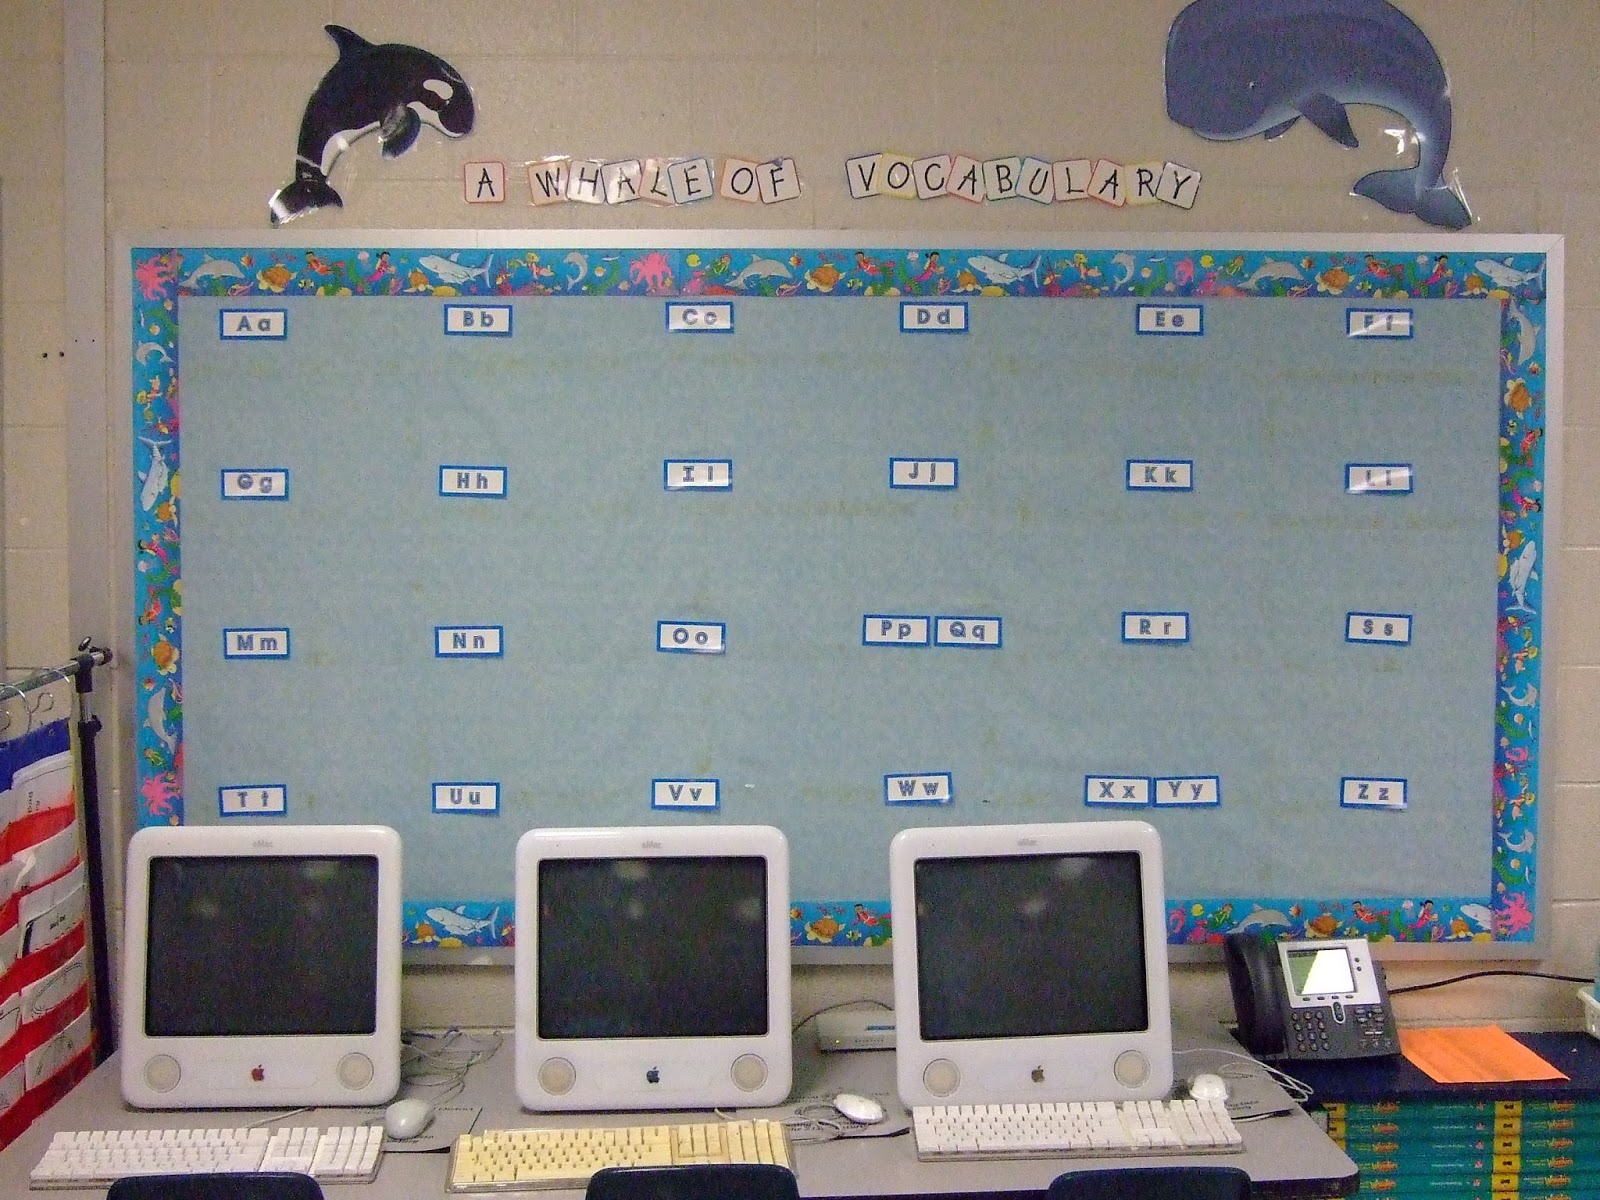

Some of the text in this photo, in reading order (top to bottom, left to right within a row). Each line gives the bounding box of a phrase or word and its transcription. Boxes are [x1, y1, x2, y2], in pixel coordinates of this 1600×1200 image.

[477, 161, 1191, 200] A WHALE OF VOCABULARY
[236, 315, 271, 332] Aa
[463, 311, 494, 327] Bb
[682, 308, 717, 324] Cc
[916, 308, 950, 324] Dd
[1155, 311, 1184, 327] Ee
[457, 473, 488, 489] Hh
[1145, 467, 1177, 483] Kk
[237, 475, 272, 493] Gg
[881, 620, 911, 640] Pp
[949, 621, 985, 641] Qq
[1139, 619, 1171, 634] Rr
[1362, 619, 1393, 635] Ss
[237, 634, 278, 651] Mm
[453, 632, 485, 649] Nn
[673, 628, 708, 643] Oo
[669, 785, 702, 801] Vv
[898, 780, 939, 796] Ww
[1099, 782, 1135, 798] Xx
[1168, 781, 1202, 800] Yy
[1358, 784, 1389, 800] Zz
[238, 792, 268, 808] Tt
[450, 788, 481, 805] Uu
